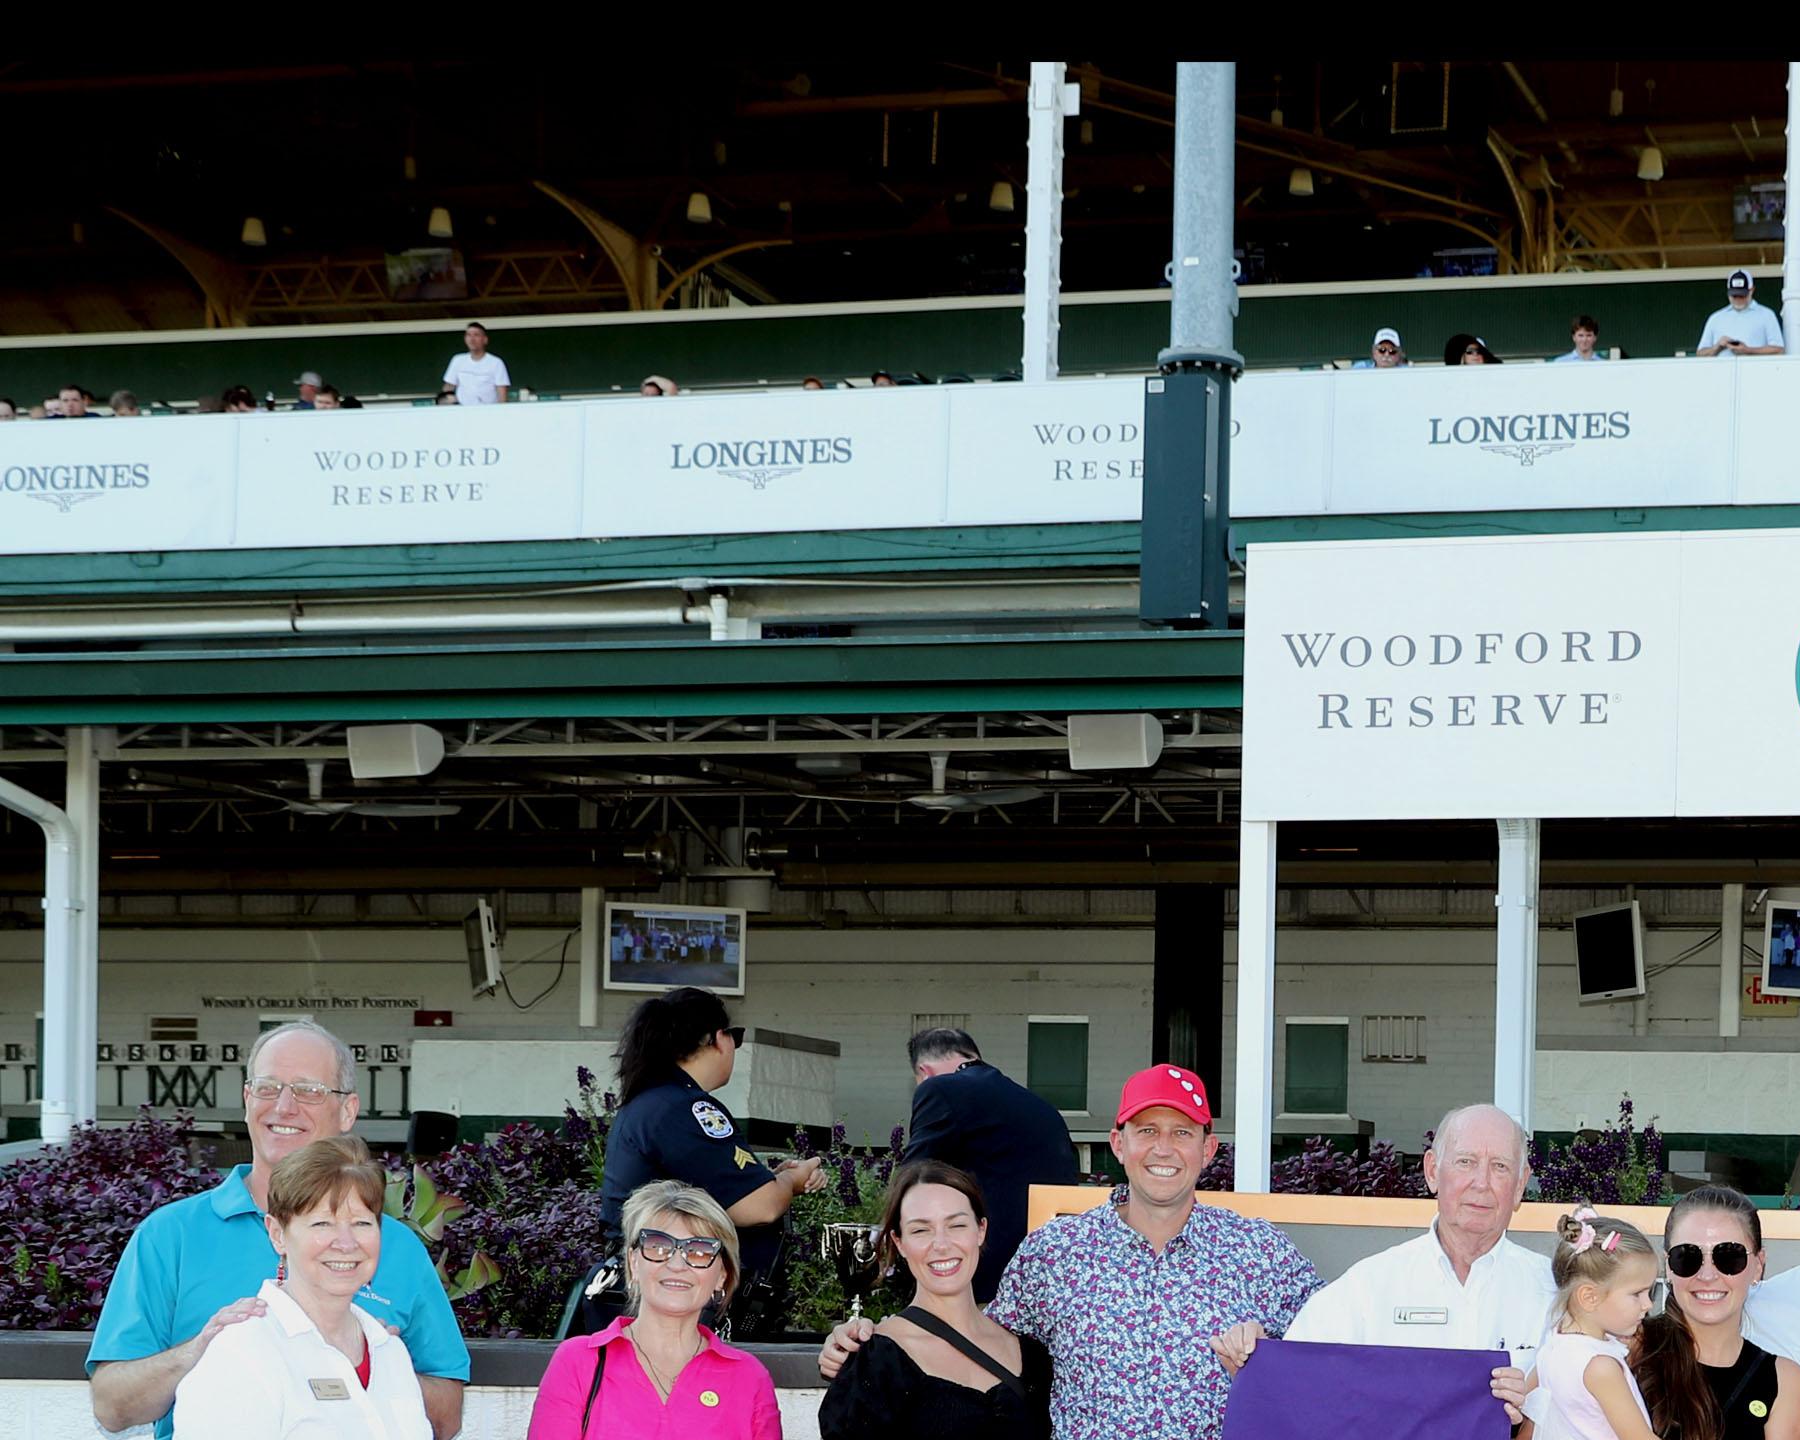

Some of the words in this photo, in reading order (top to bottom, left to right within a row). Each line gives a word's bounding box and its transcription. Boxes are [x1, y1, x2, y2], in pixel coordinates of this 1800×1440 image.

[1429, 411, 1630, 445] LONGINES
[314, 447, 500, 471] WOODFORD
[671, 437, 853, 469] LONGINES
[0, 463, 150, 492] ONGINES
[1053, 459, 1143, 481] RESE
[331, 482, 484, 506] RESERVE
[1281, 630, 1642, 668] WOODFORD
[1317, 693, 1609, 729] RESERVE
